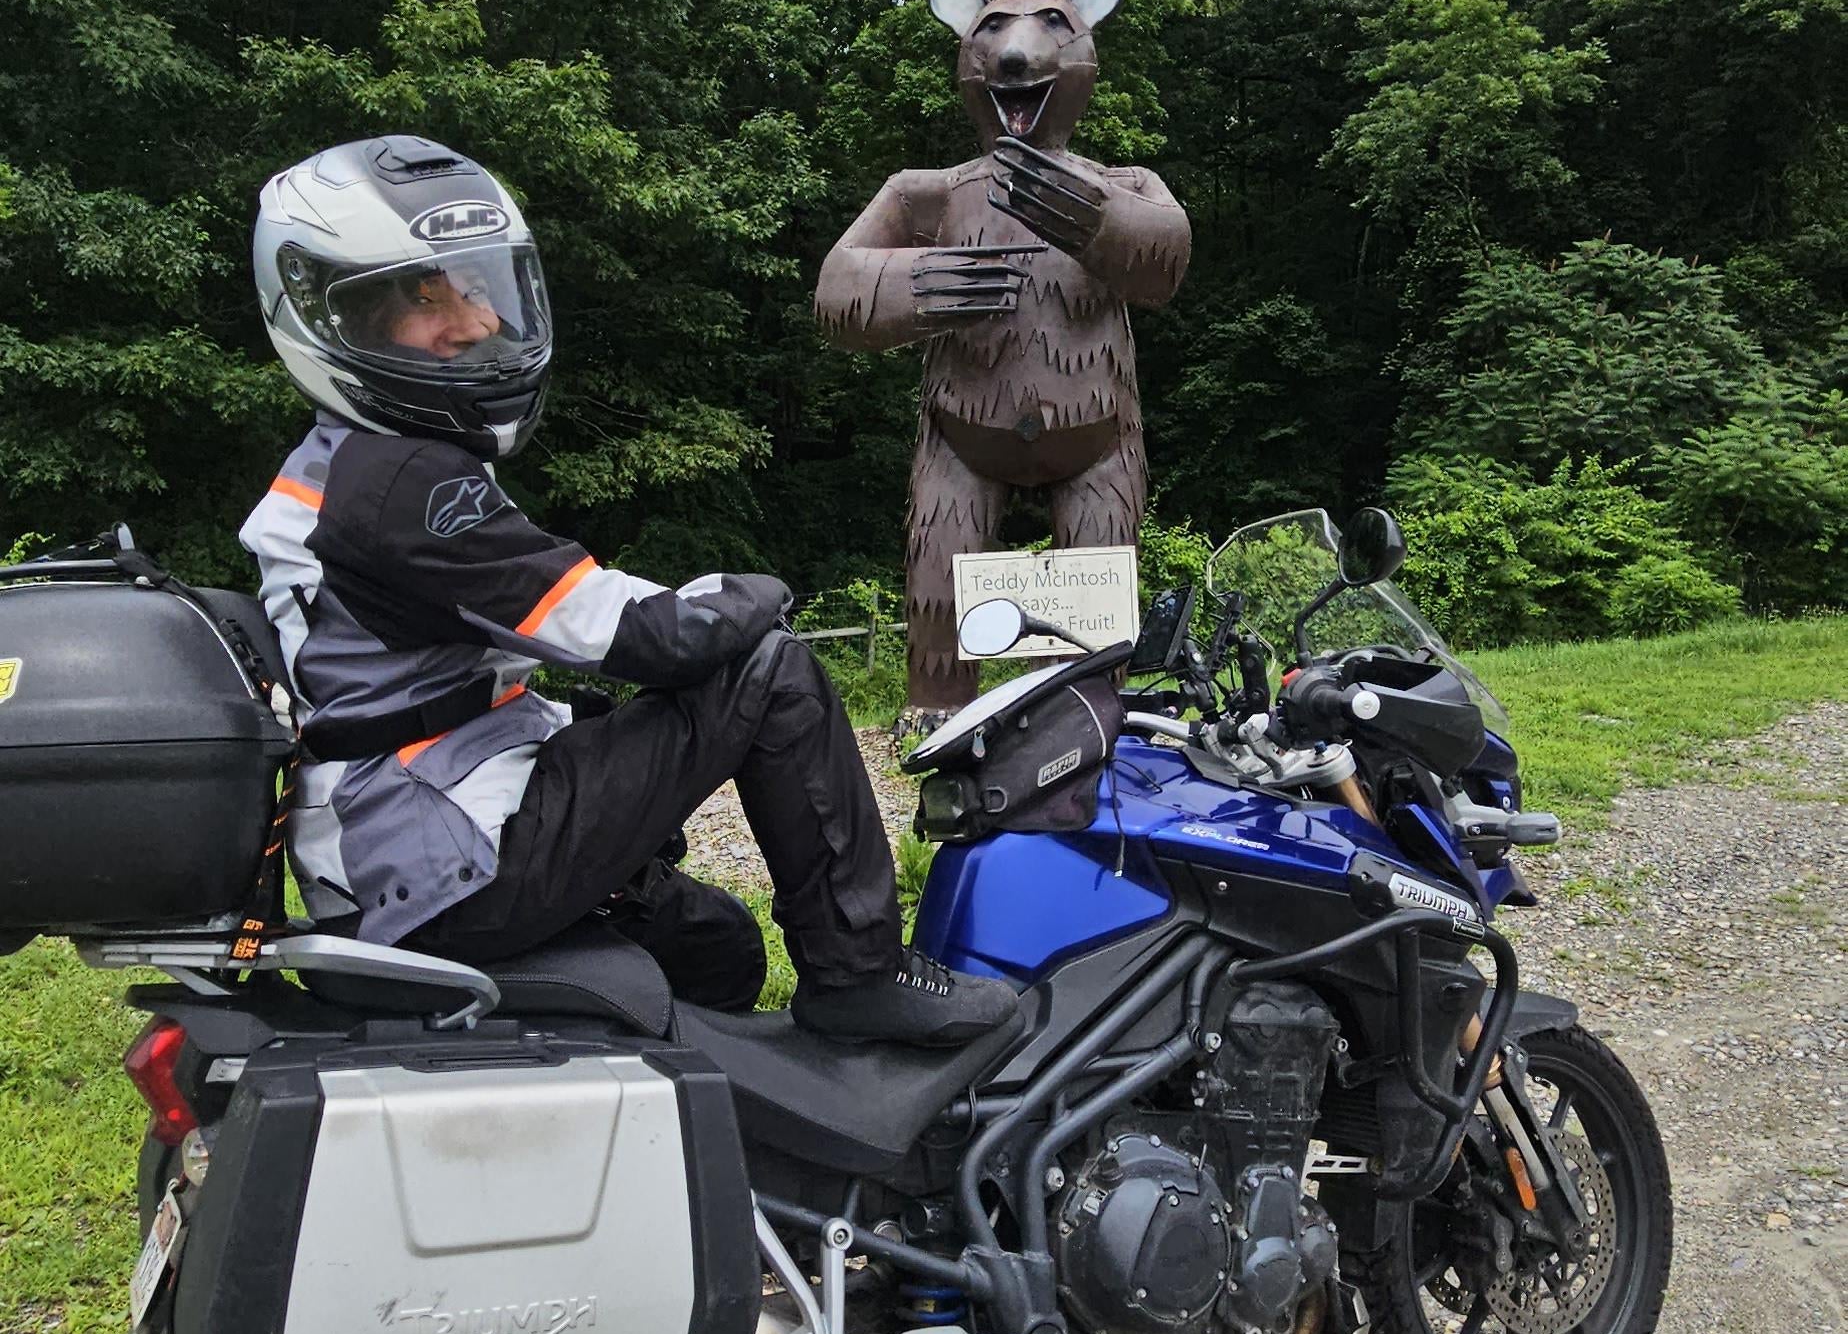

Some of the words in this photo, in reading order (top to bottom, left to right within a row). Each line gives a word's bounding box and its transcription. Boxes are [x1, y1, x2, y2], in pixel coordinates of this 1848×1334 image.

[428, 208, 498, 237] HJC
[970, 573, 1029, 593] Teddy
[1035, 568, 1120, 588] McIntosh
[1021, 597, 1074, 616] says...
[1068, 614, 1115, 631] Fruit!
[1398, 882, 1467, 919] TRIUMPH
